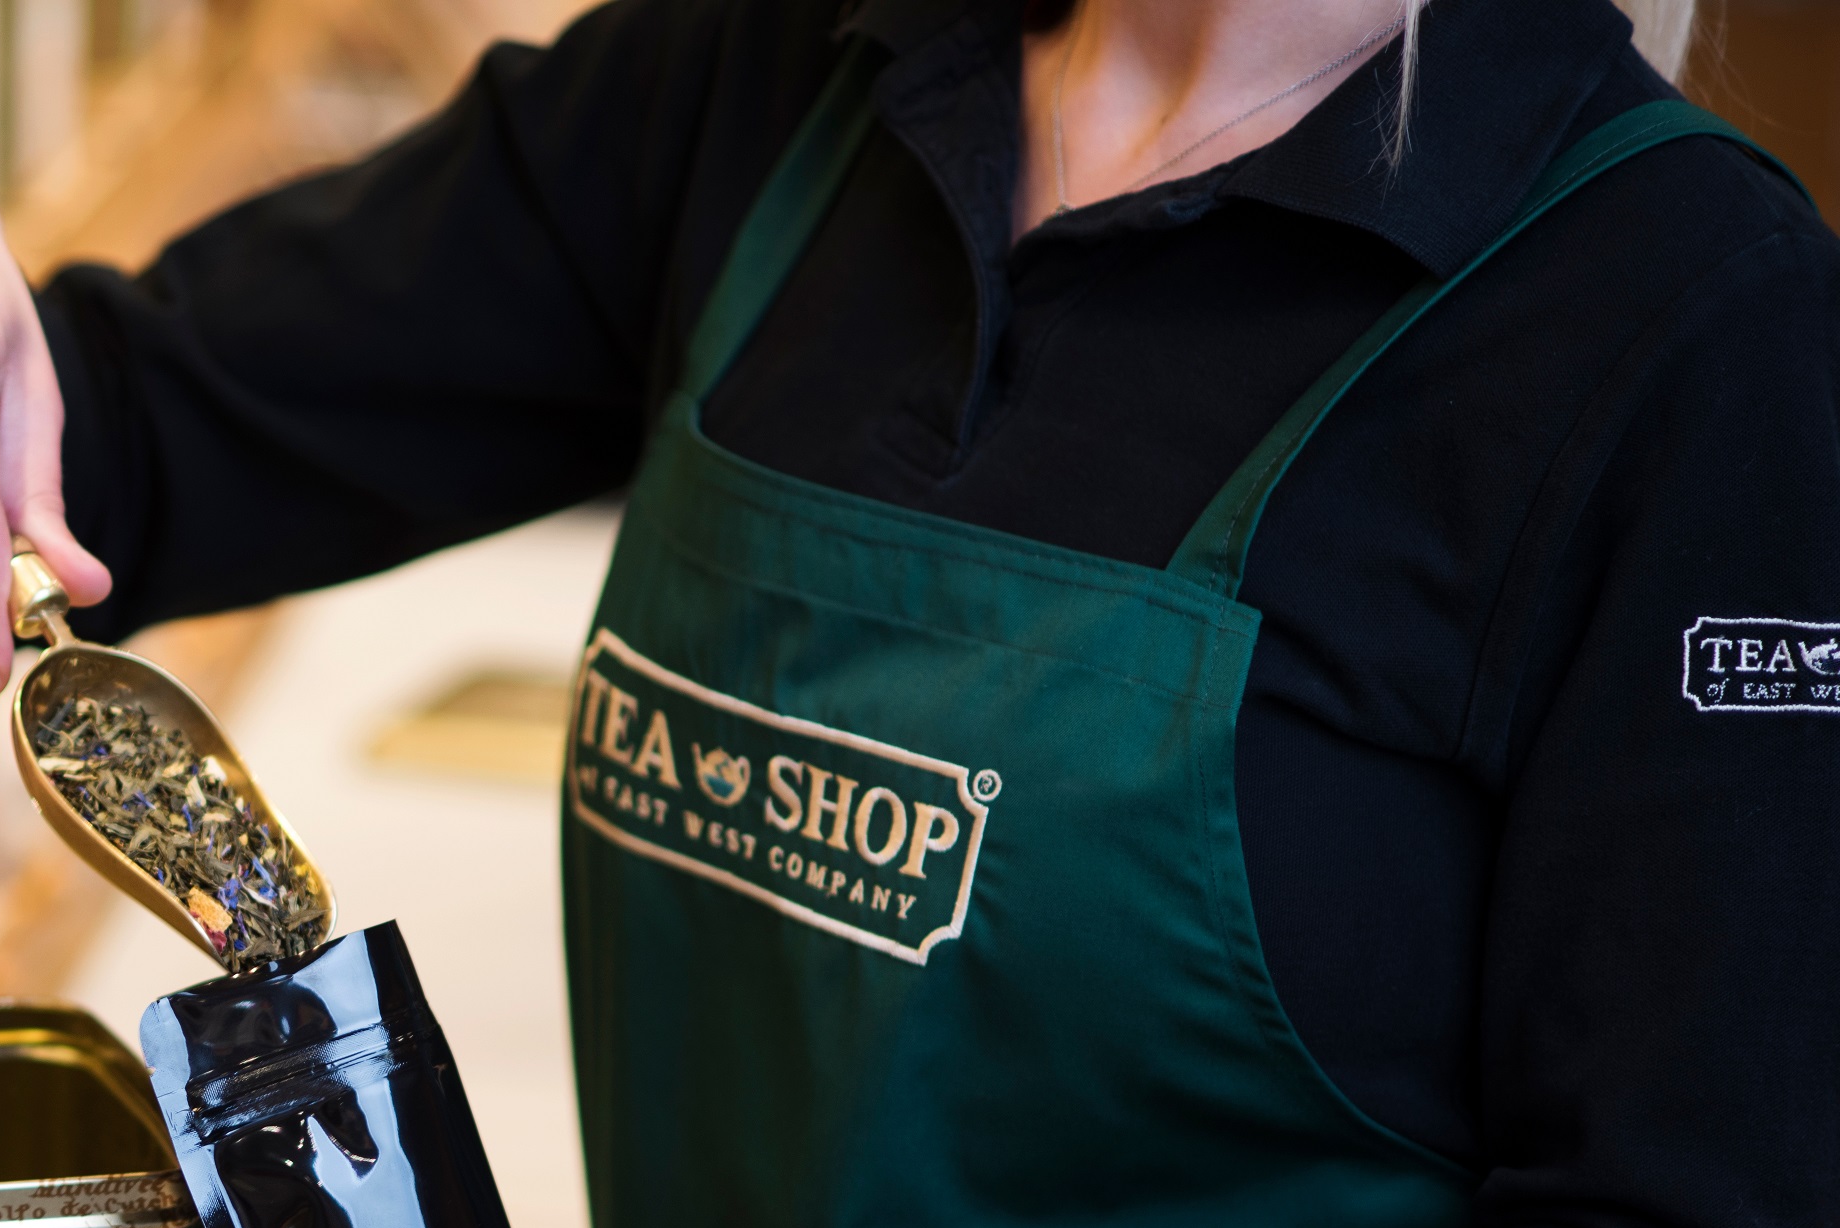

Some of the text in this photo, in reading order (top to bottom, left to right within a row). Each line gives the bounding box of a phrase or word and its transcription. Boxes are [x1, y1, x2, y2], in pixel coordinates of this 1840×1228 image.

[1700, 637, 1797, 673] TEA
[1707, 678, 1730, 703] of
[1743, 682, 1796, 699] EAST
[580, 668, 960, 880] TEA SHOP
[682, 809, 756, 860] WEST
[768, 847, 917, 919] COMPANY
